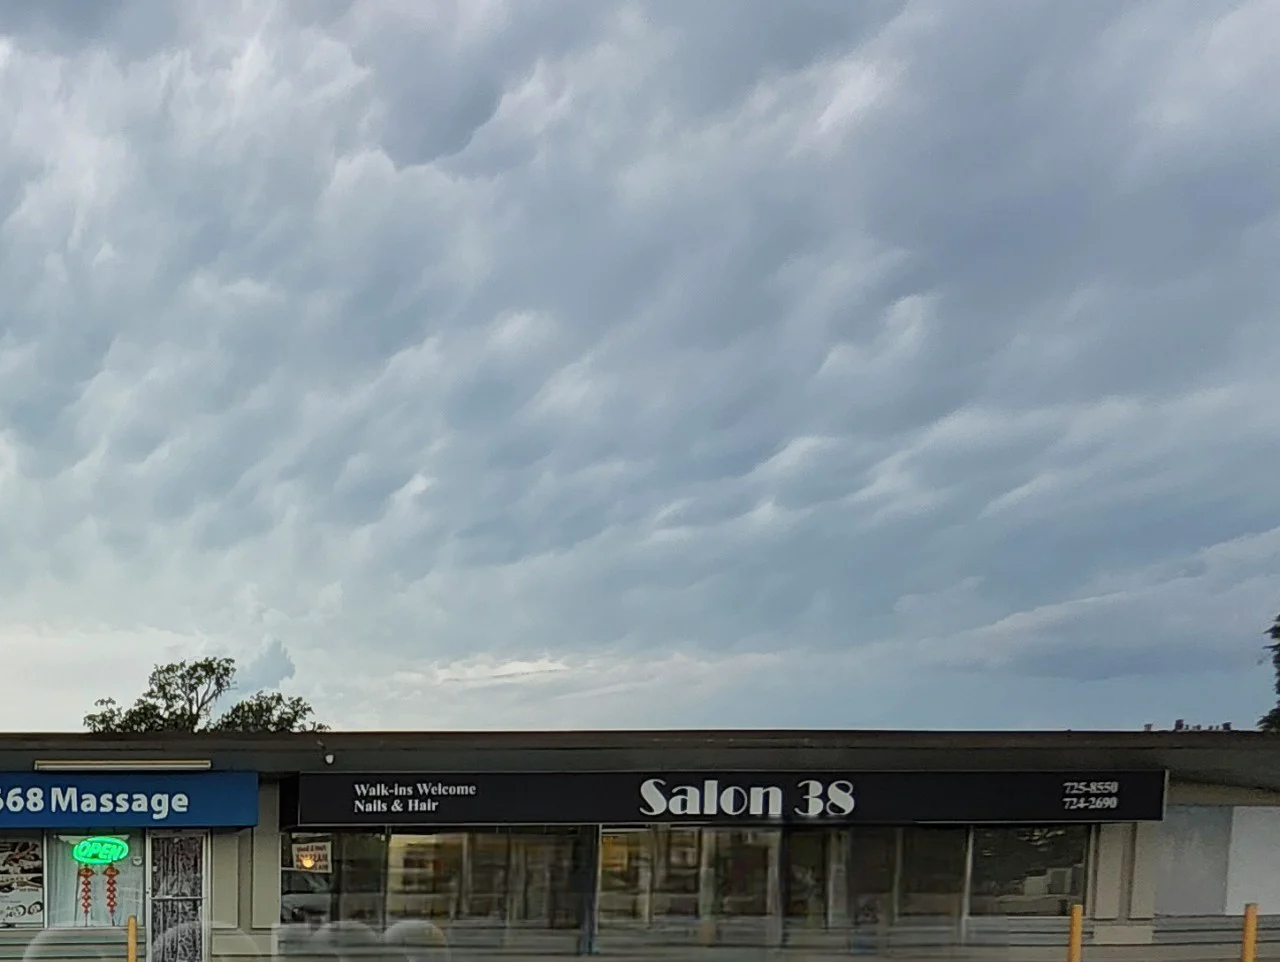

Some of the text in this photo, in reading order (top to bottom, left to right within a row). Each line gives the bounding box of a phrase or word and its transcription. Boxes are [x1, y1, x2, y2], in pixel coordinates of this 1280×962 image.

[354, 781, 477, 797] Walk-ins Welcome
[639, 778, 855, 817] Salon 38
[51, 787, 189, 820] Massage
[354, 798, 439, 813] Nails & Hair
[1062, 796, 1118, 810] 724-2690
[76, 840, 123, 861] OPEN
